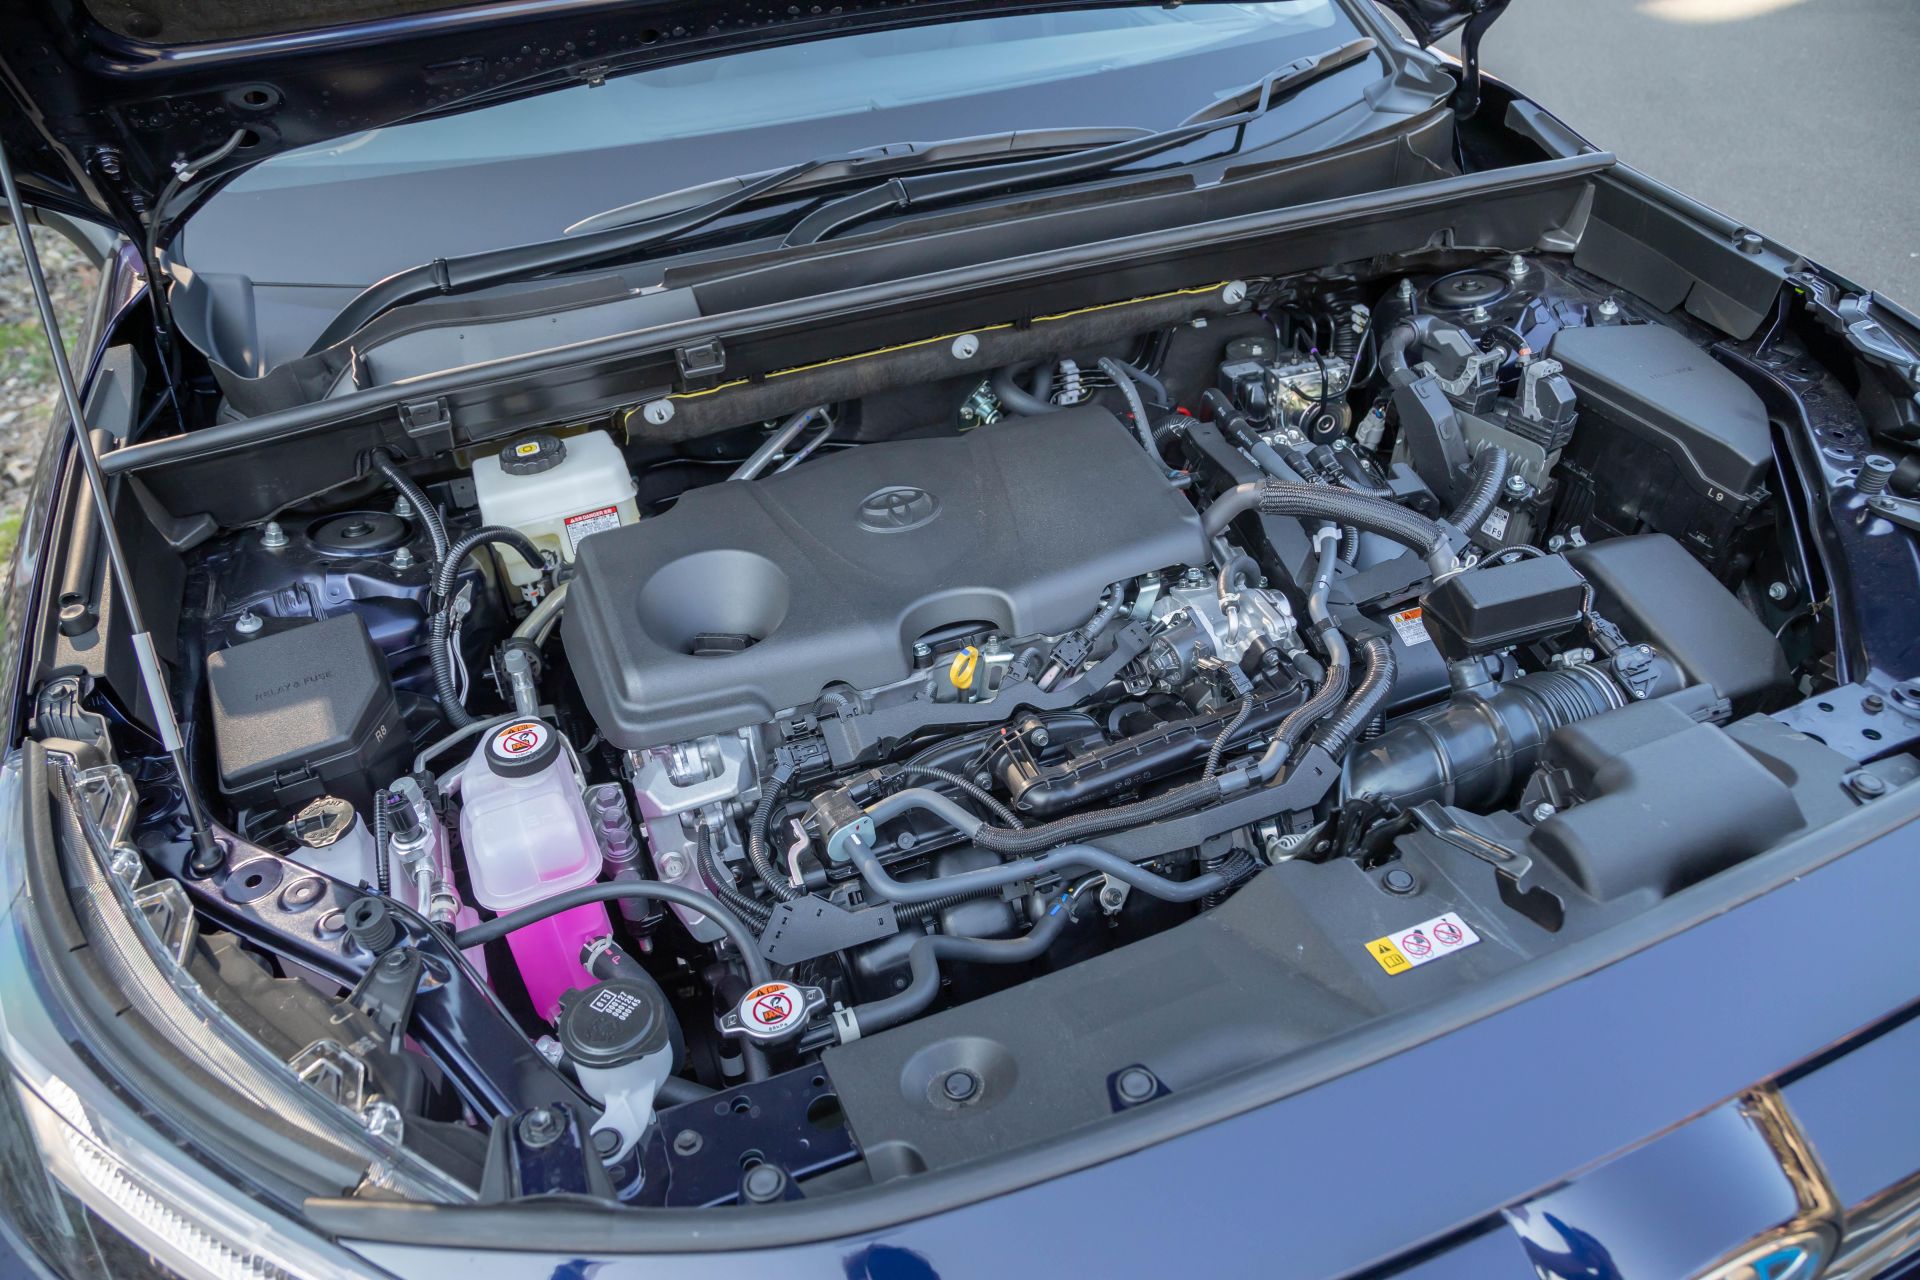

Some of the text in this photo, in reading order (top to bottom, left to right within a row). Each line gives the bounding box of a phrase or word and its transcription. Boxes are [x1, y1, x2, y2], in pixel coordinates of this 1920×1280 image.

[1707, 487, 1724, 501] L9
[582, 511, 604, 520] DANGER
[1491, 527, 1502, 538] F9
[375, 724, 387, 743] R8
[605, 991, 627, 1014] 000127
[611, 995, 634, 1017] 000128
